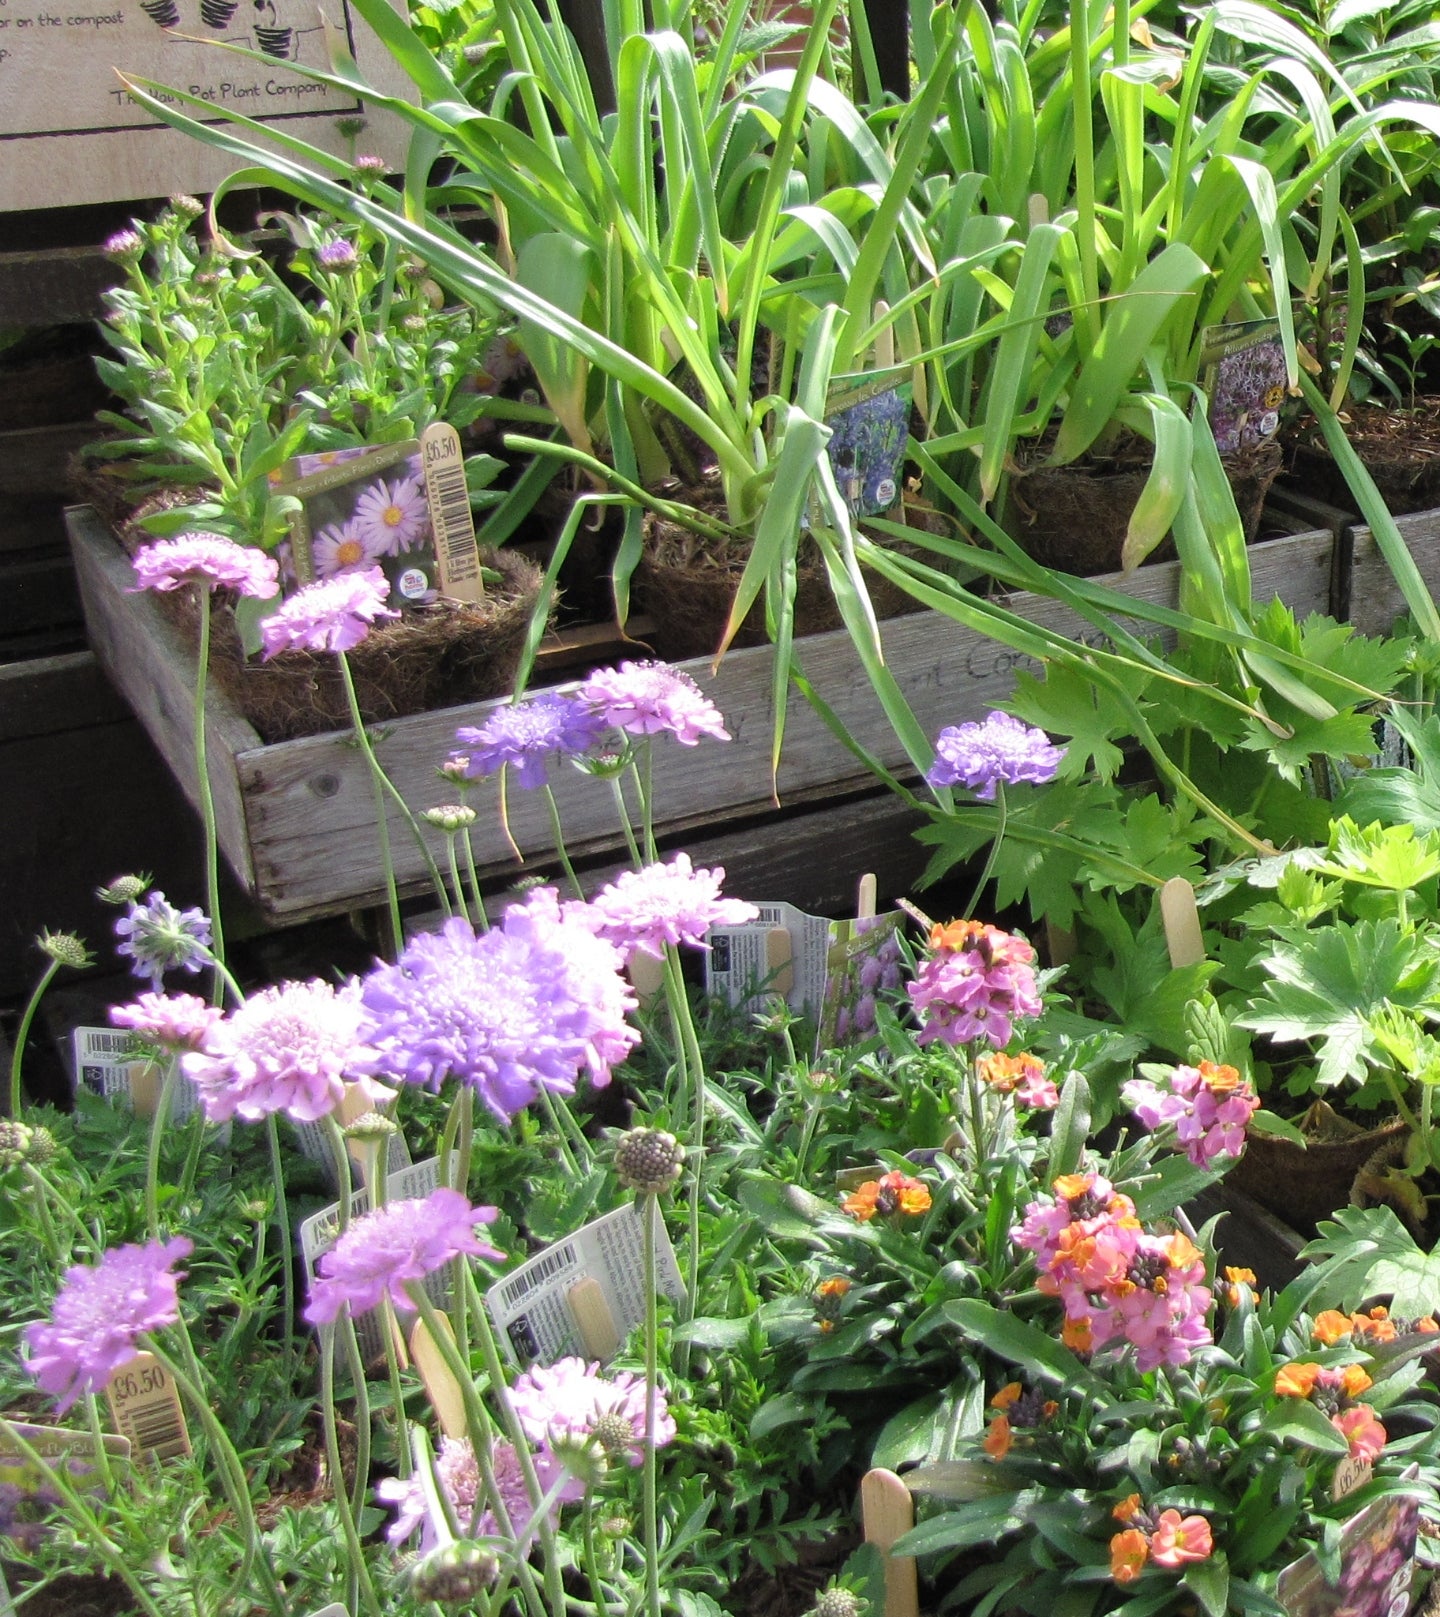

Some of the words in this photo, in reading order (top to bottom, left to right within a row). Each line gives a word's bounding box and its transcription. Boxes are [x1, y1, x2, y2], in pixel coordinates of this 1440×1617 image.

[16, 19, 34, 28] on
[37, 13, 62, 27] the
[67, 10, 125, 29] compost
[188, 84, 216, 101] Pot
[220, 82, 262, 99] Plant
[264, 79, 328, 101] Company
[425, 435, 458, 462] £6.50
[114, 1365, 166, 1400] £6.50
